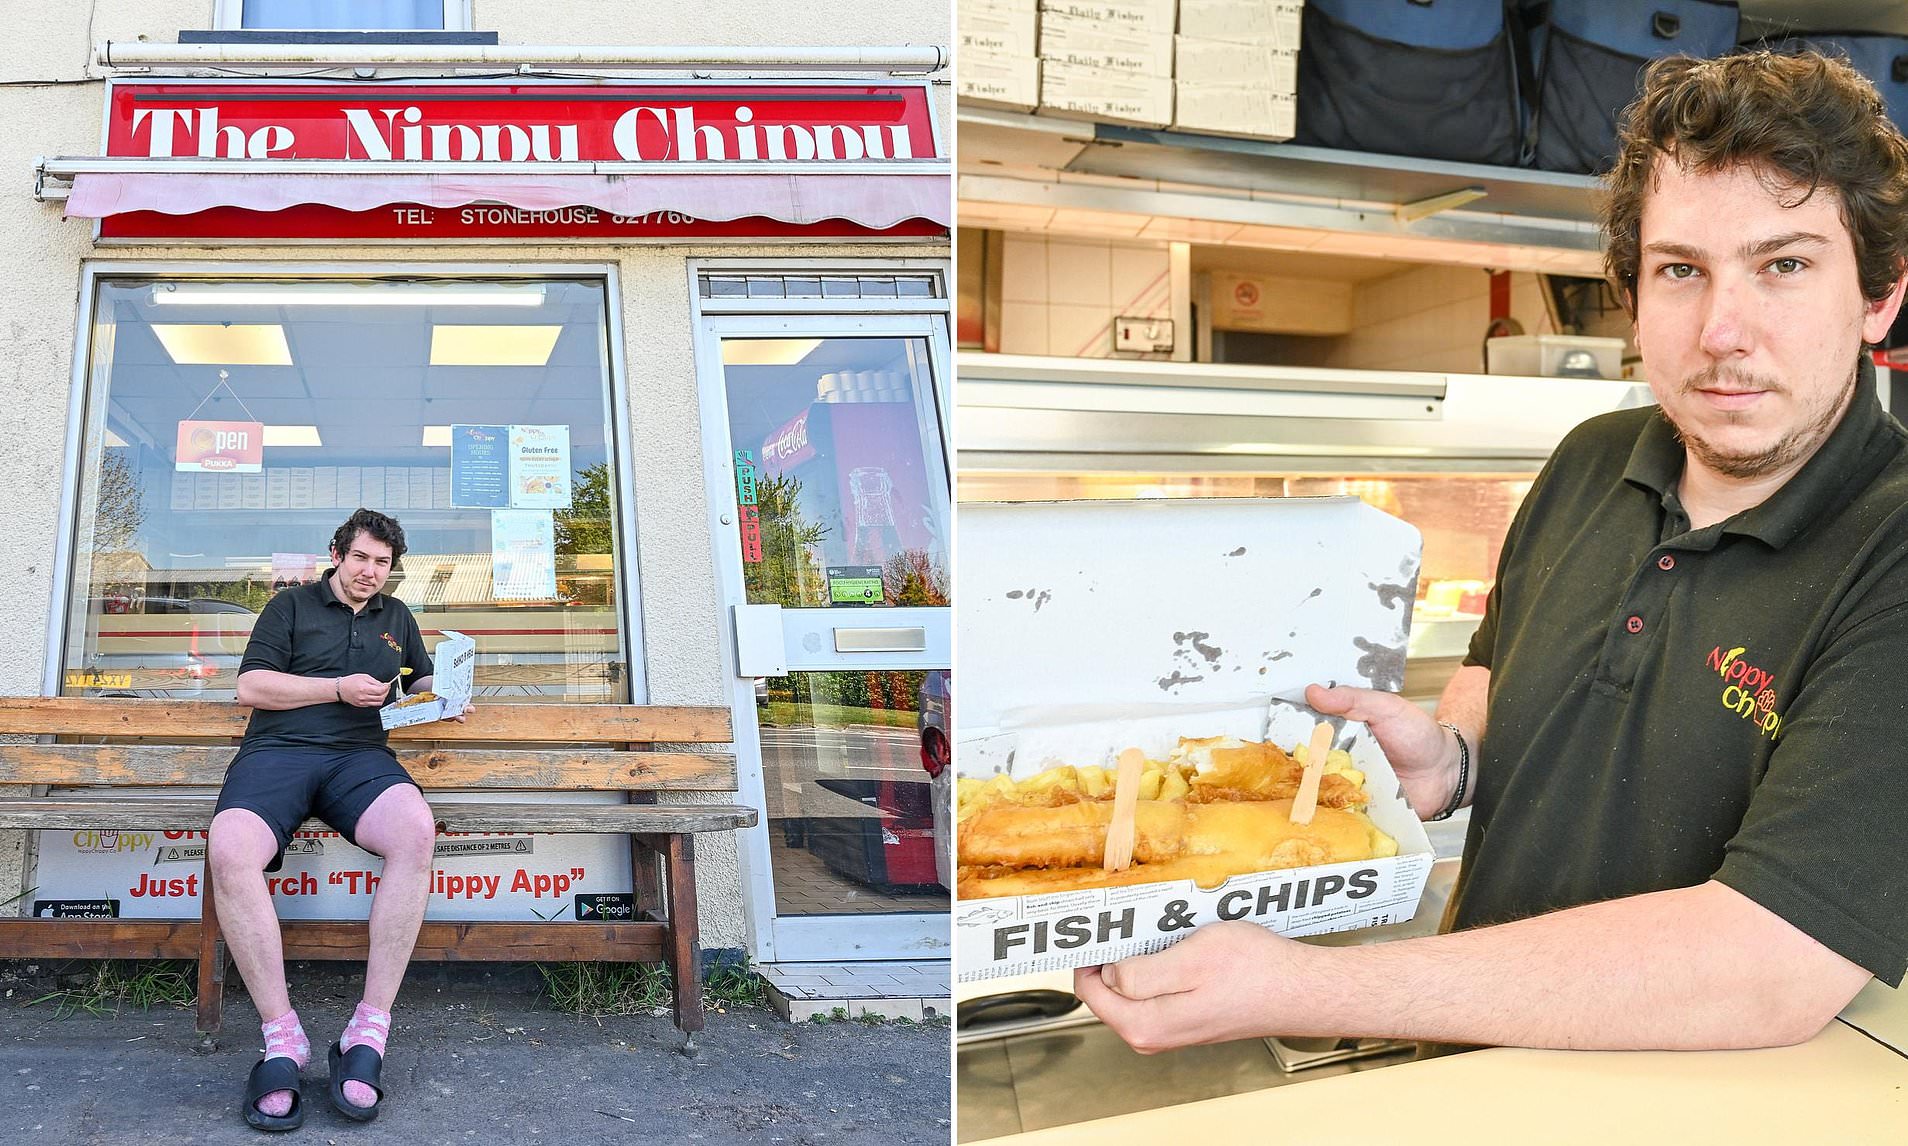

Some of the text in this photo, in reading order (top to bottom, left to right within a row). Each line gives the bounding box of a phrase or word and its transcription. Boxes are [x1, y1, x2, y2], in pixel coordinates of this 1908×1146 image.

[132, 106, 297, 160] The
[461, 208, 600, 225] STONEHOUSE
[521, 446, 559, 454] Gluten Free
[741, 467, 753, 503] PUSH
[183, 848, 204, 857] PLEASE
[437, 845, 451, 853] SAFE
[451, 844, 477, 852] DISTANCE
[478, 843, 485, 851] OF
[490, 842, 511, 851] METRES
[130, 873, 198, 898] Just
[268, 871, 318, 896] rch
[328, 871, 382, 895] “Th
[596, 903, 631, 916] Google
[993, 908, 1135, 961] FISH
[1157, 899, 1198, 932] &
[1217, 869, 1379, 921] CHIPS
